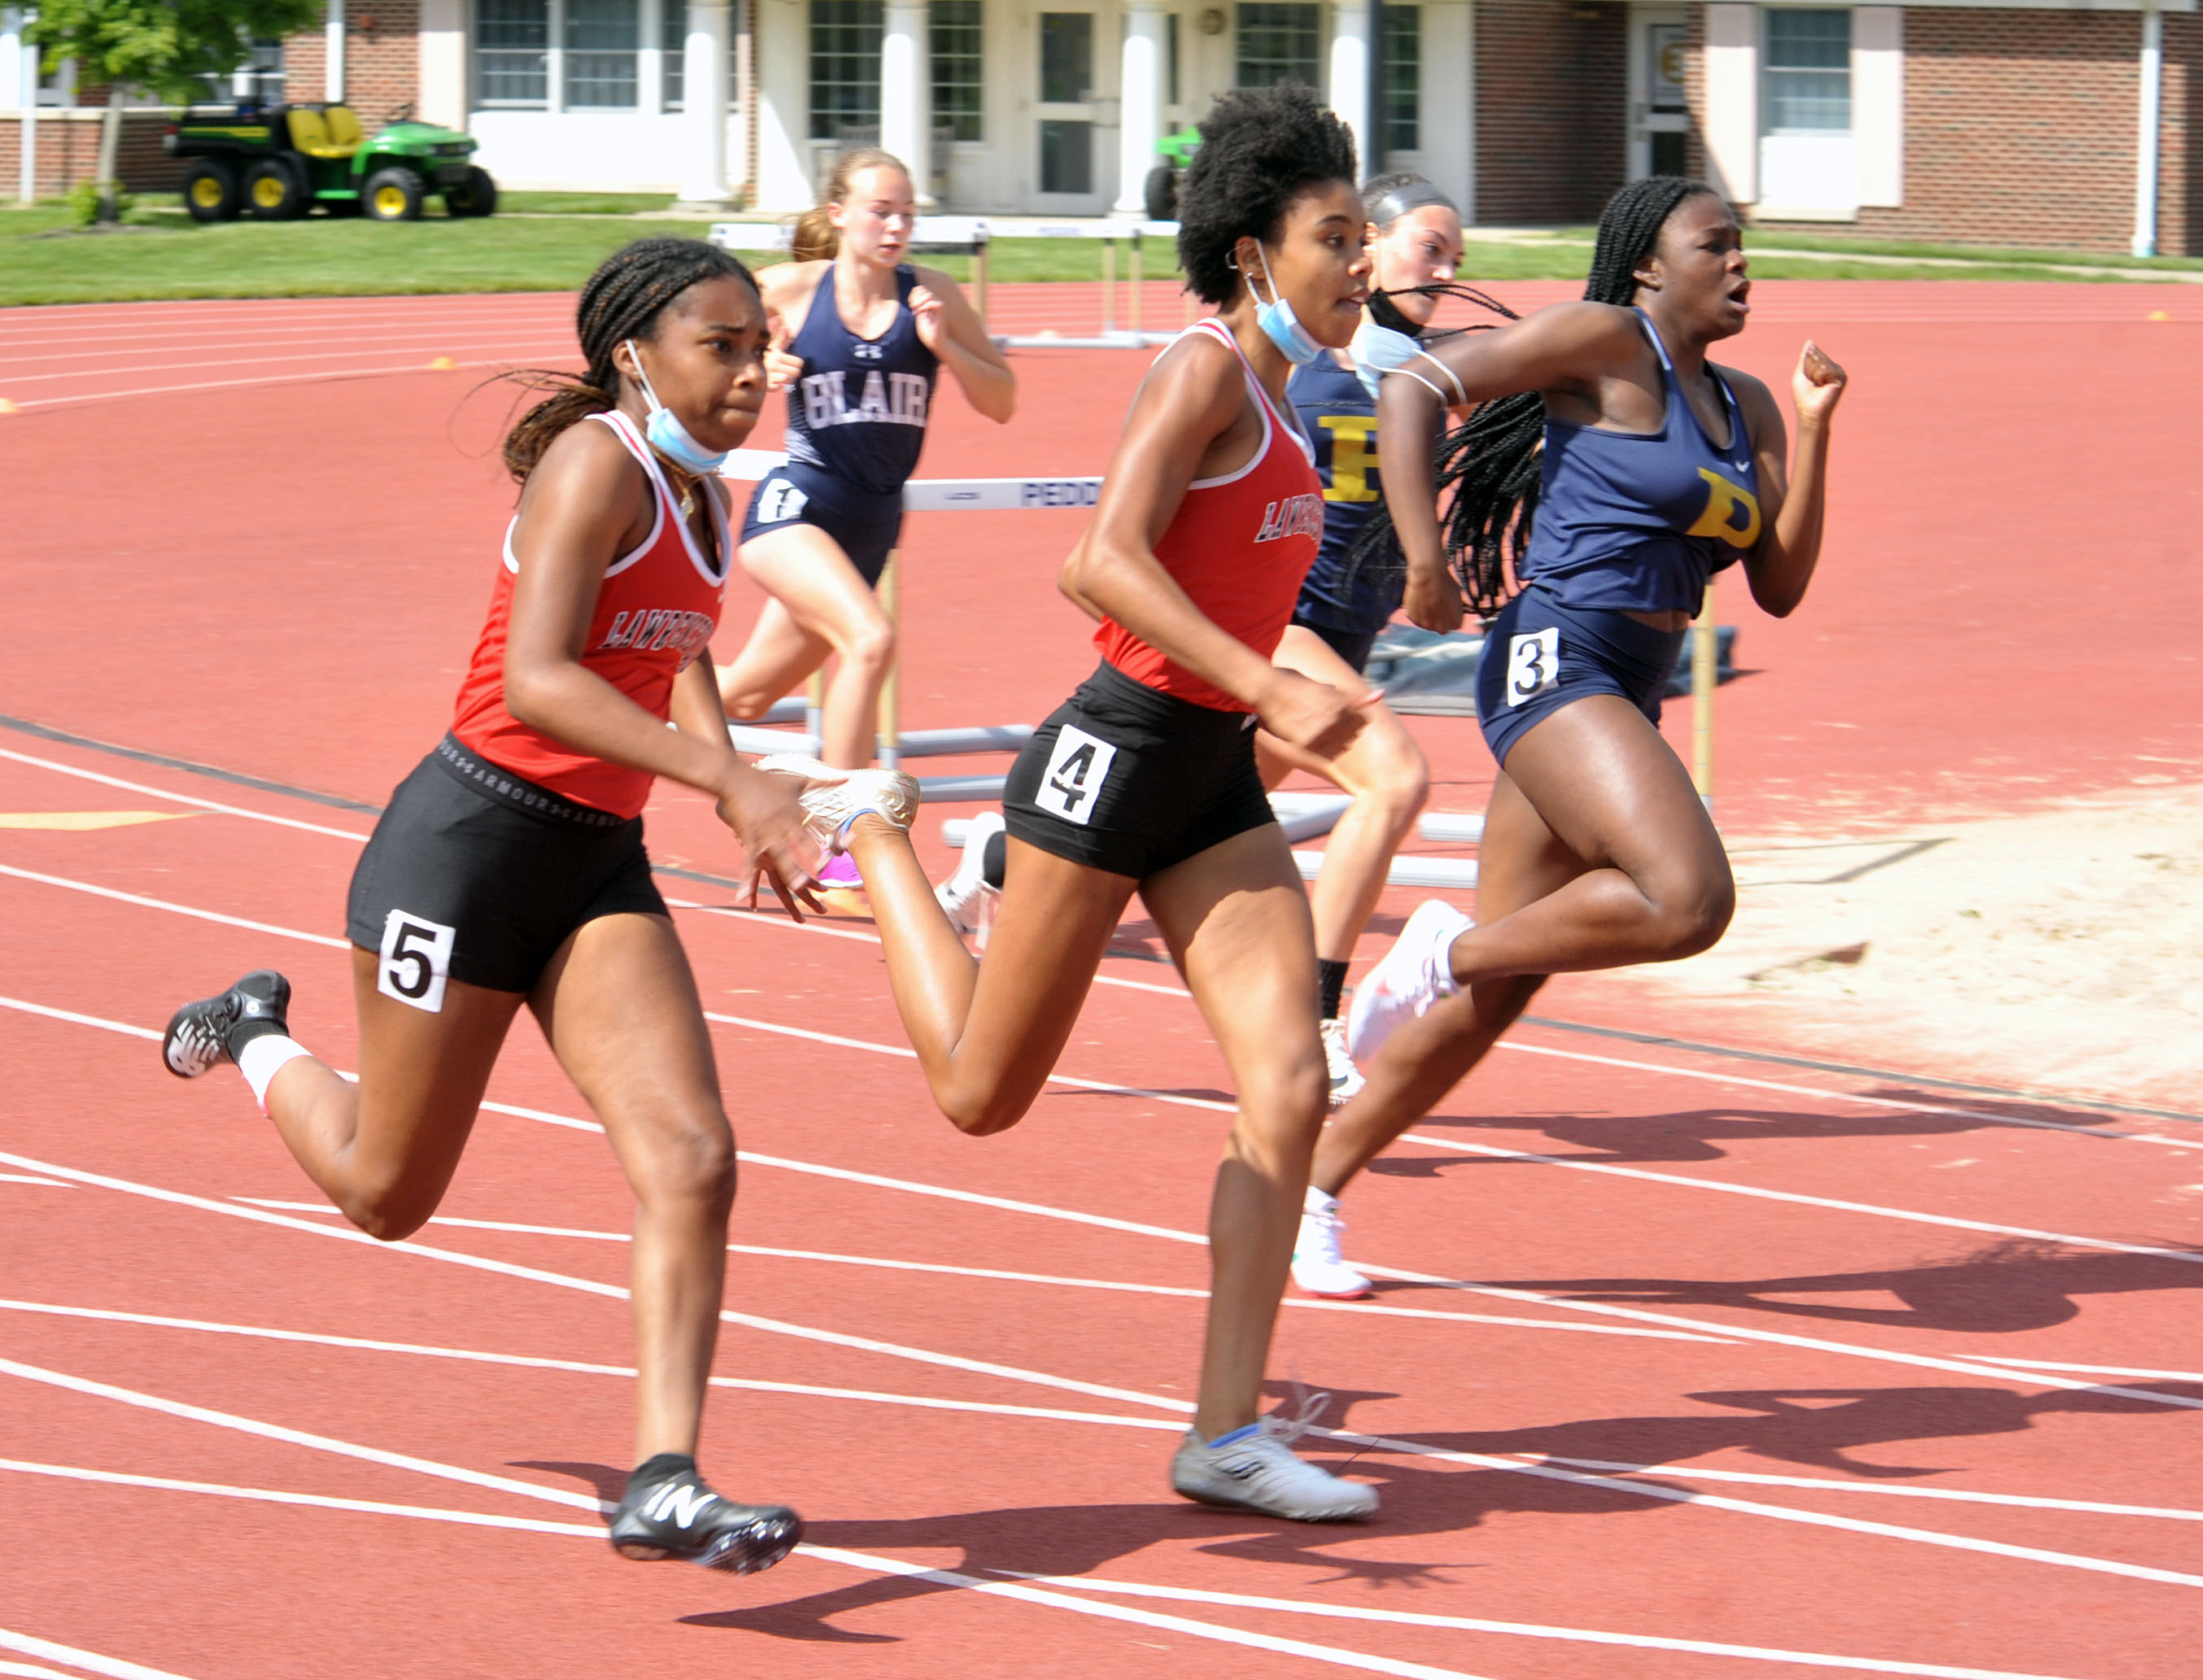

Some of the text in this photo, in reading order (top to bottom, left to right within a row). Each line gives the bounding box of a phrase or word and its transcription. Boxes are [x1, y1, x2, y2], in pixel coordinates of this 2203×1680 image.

[801, 370, 928, 430] BLAIR
[1686, 466, 1761, 549] P
[1515, 638, 1545, 696] 3
[473, 769, 550, 810] ARMOUR
[1050, 742, 1097, 813] 4
[389, 921, 438, 999] 5
